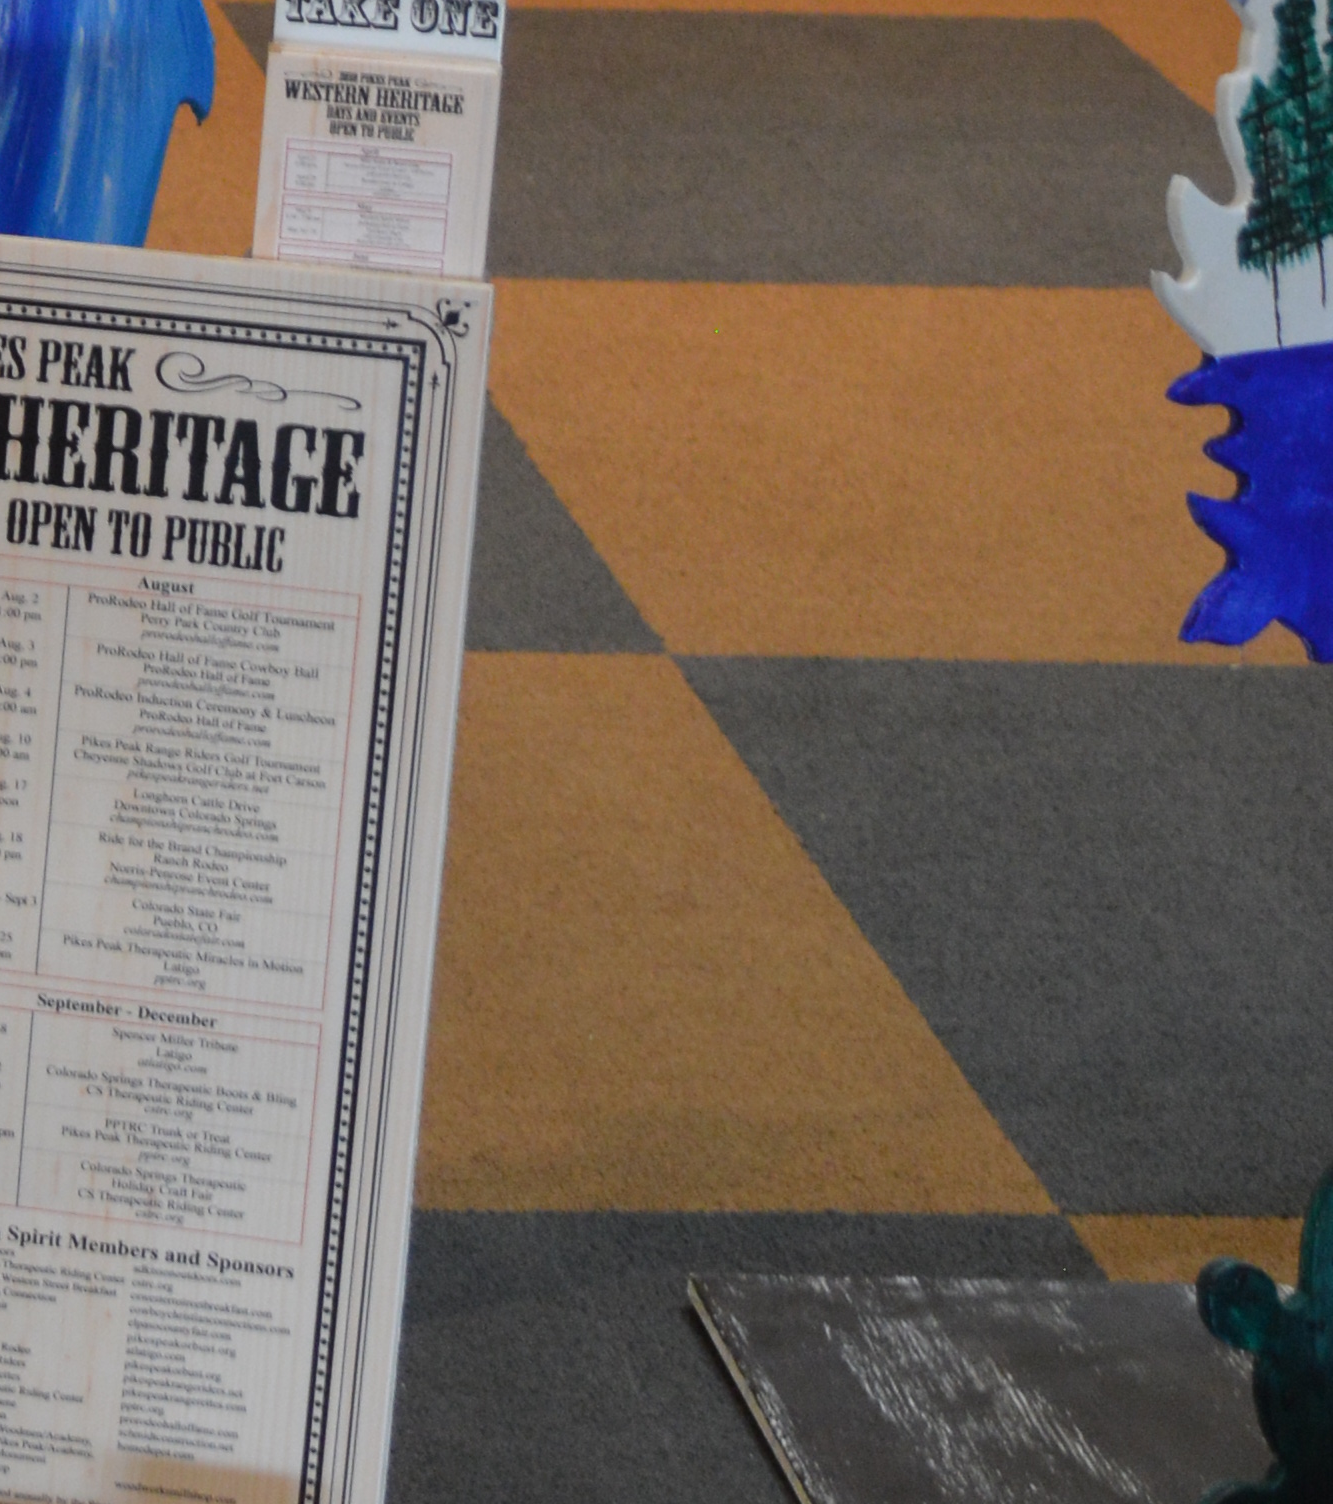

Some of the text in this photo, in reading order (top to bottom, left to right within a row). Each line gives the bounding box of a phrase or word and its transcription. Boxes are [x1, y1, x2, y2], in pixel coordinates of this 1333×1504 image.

[284, 78, 465, 115] WESTERN HERITAGE
[326, 105, 420, 127] DAYS AND EVENTS
[329, 120, 357, 137] OPEN
[35, 338, 137, 393] PEAK
[5, 497, 99, 553] OPEN
[106, 508, 153, 559] TO
[161, 514, 286, 574] PUBLIC
[137, 575, 195, 596] August
[87, 590, 336, 632] ProRodeo Hall of Fame Golf Tournament
[139, 610, 281, 639] Perry Park Country Club
[80, 733, 321, 775] Pikes Peak Range Riders Golf Tournament
[36, 993, 122, 1017] September
[137, 1005, 217, 1029] December
[6, 1225, 62, 1248] Spirit
[67, 1232, 159, 1261] Members
[164, 1249, 201, 1267] and
[206, 1252, 295, 1279] Sponsors
